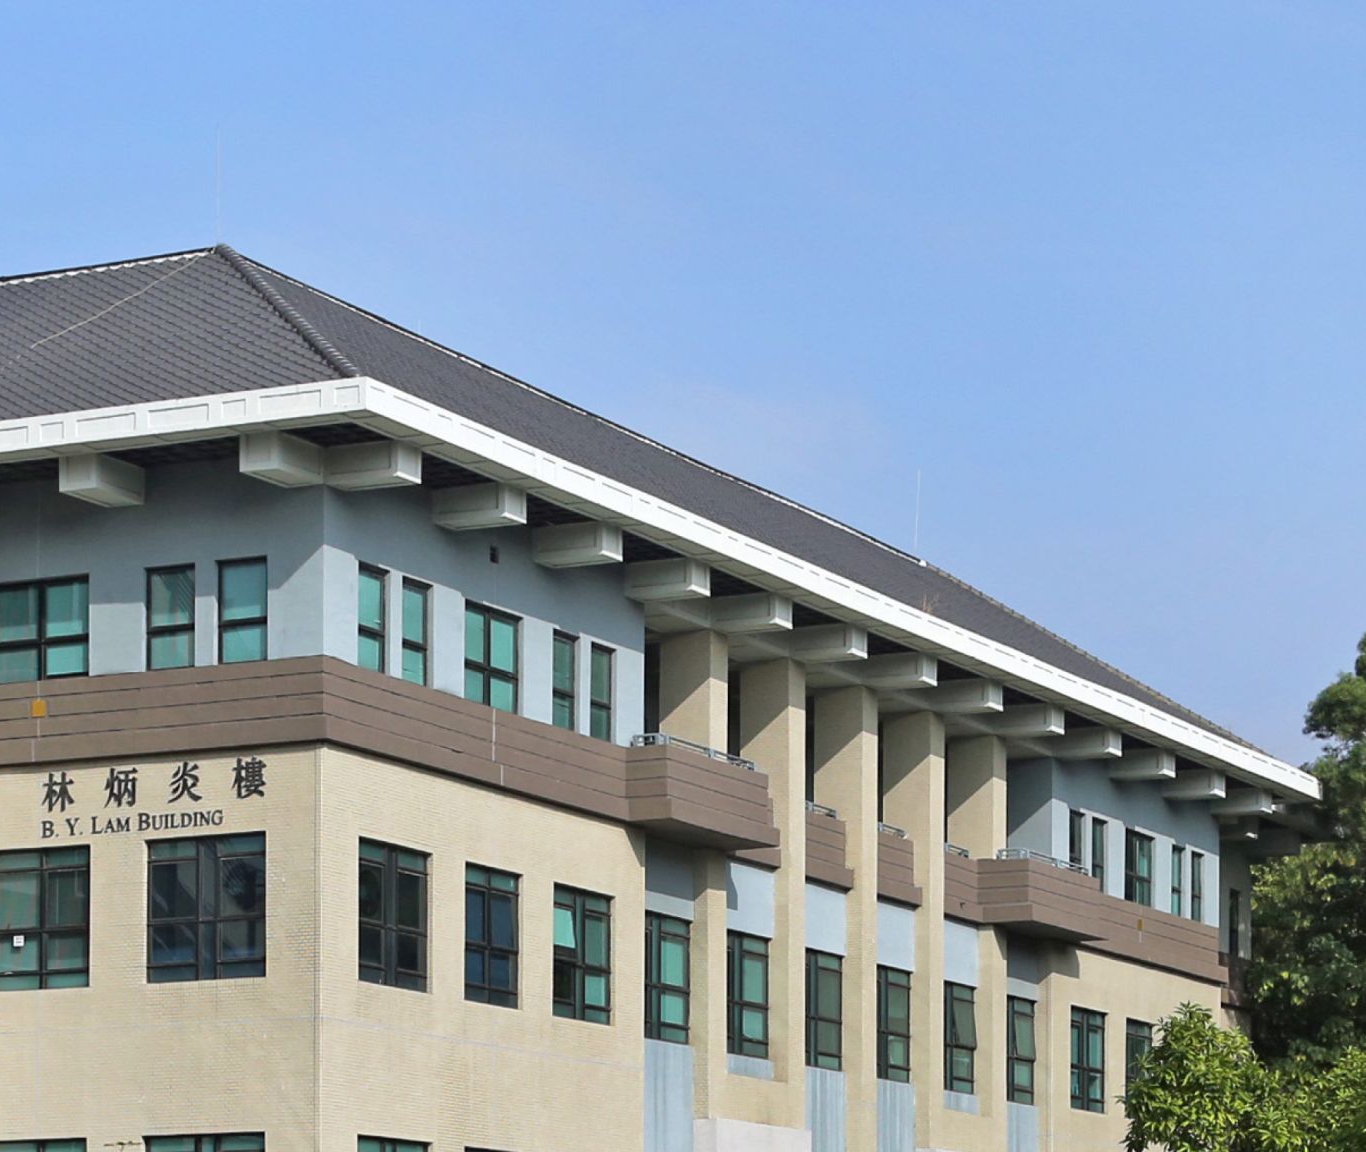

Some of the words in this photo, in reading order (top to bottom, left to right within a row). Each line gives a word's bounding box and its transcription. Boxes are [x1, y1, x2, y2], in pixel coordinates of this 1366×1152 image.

[41, 756, 267, 812] 林炳炎樓
[41, 821, 59, 839] B.
[66, 818, 83, 836] Y.
[92, 814, 131, 834] LAM
[138, 810, 224, 832] BUILDING
